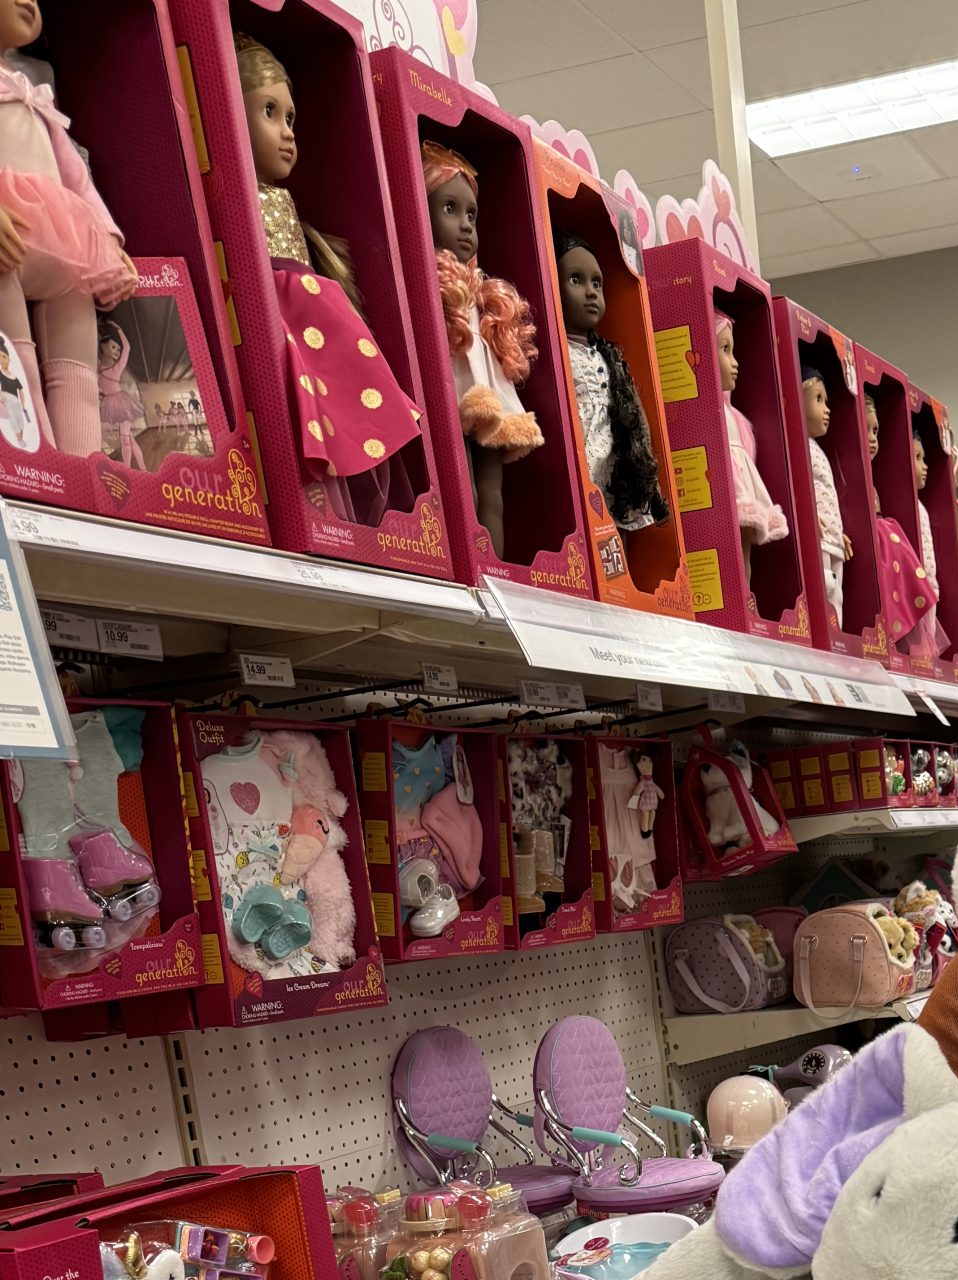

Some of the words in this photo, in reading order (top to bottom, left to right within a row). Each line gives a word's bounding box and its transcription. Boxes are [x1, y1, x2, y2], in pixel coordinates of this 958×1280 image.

[408, 69, 452, 106] Mirabelle
[14, 463, 65, 487] WARNING:
[162, 470, 262, 518] generation
[377, 519, 446, 559] generation
[530, 559, 589, 590] generation
[105, 630, 128, 642] 10.99
[589, 646, 616, 664] Meet
[616, 653, 636, 666] your
[245, 664, 266, 675] 14.99
[196, 720, 225, 732] Deluxe
[199, 732, 225, 745] Outfit
[135, 957, 199, 986] generation
[294, 982, 310, 991] Cream
[335, 977, 384, 1002] generation
[251, 1000, 283, 1012] WARNING:
[65, 1268, 79, 1280] the
